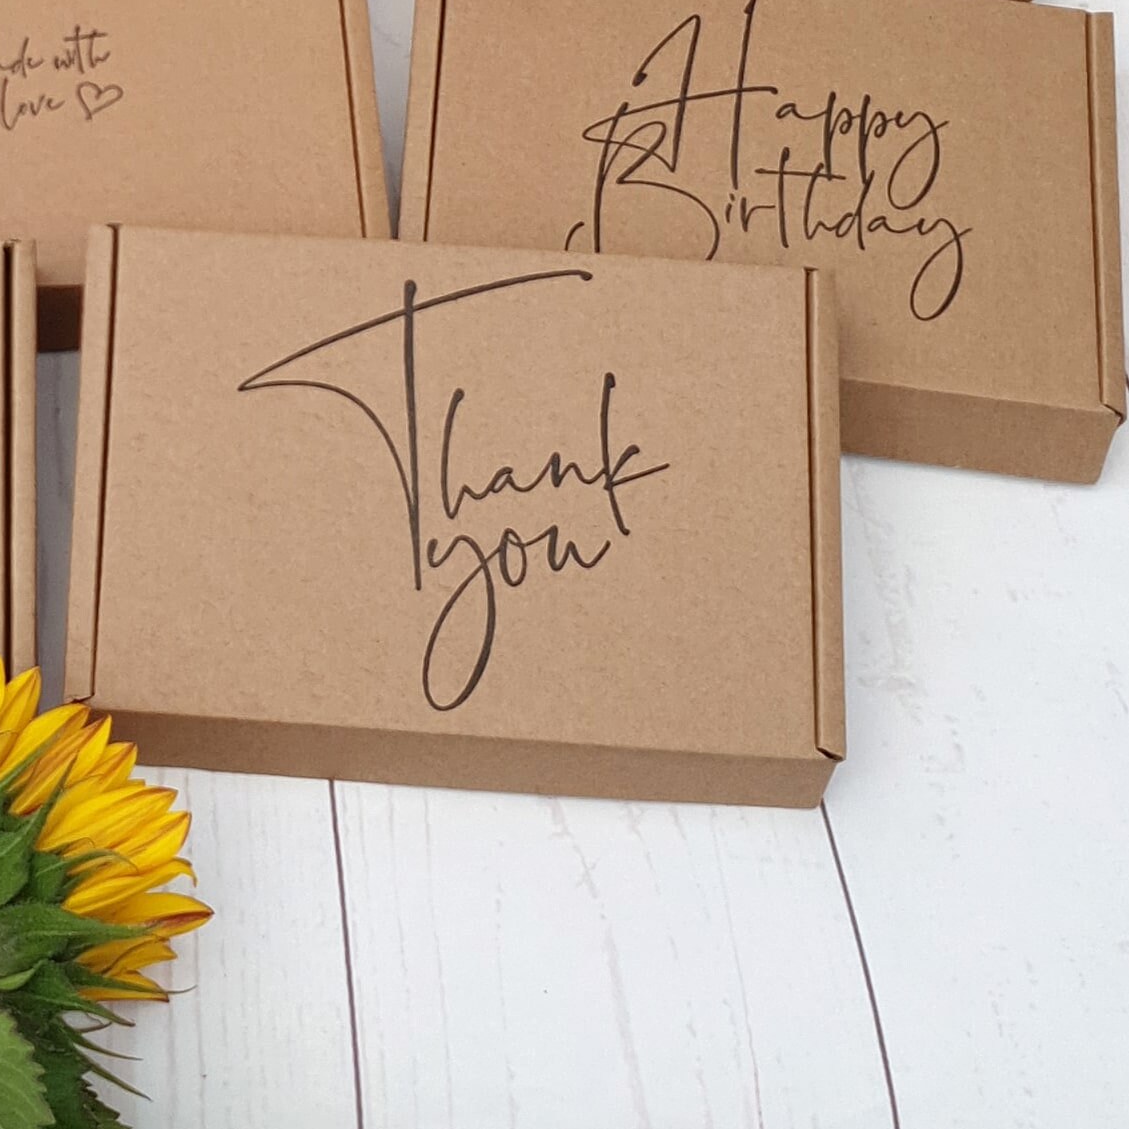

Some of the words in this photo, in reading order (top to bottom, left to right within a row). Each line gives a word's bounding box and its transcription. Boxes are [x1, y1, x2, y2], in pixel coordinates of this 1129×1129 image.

[0, 77, 66, 131] love
[53, 25, 111, 74] with
[565, 101, 973, 322] Birthday
[238, 269, 671, 592] Thank
[421, 525, 612, 712] you
